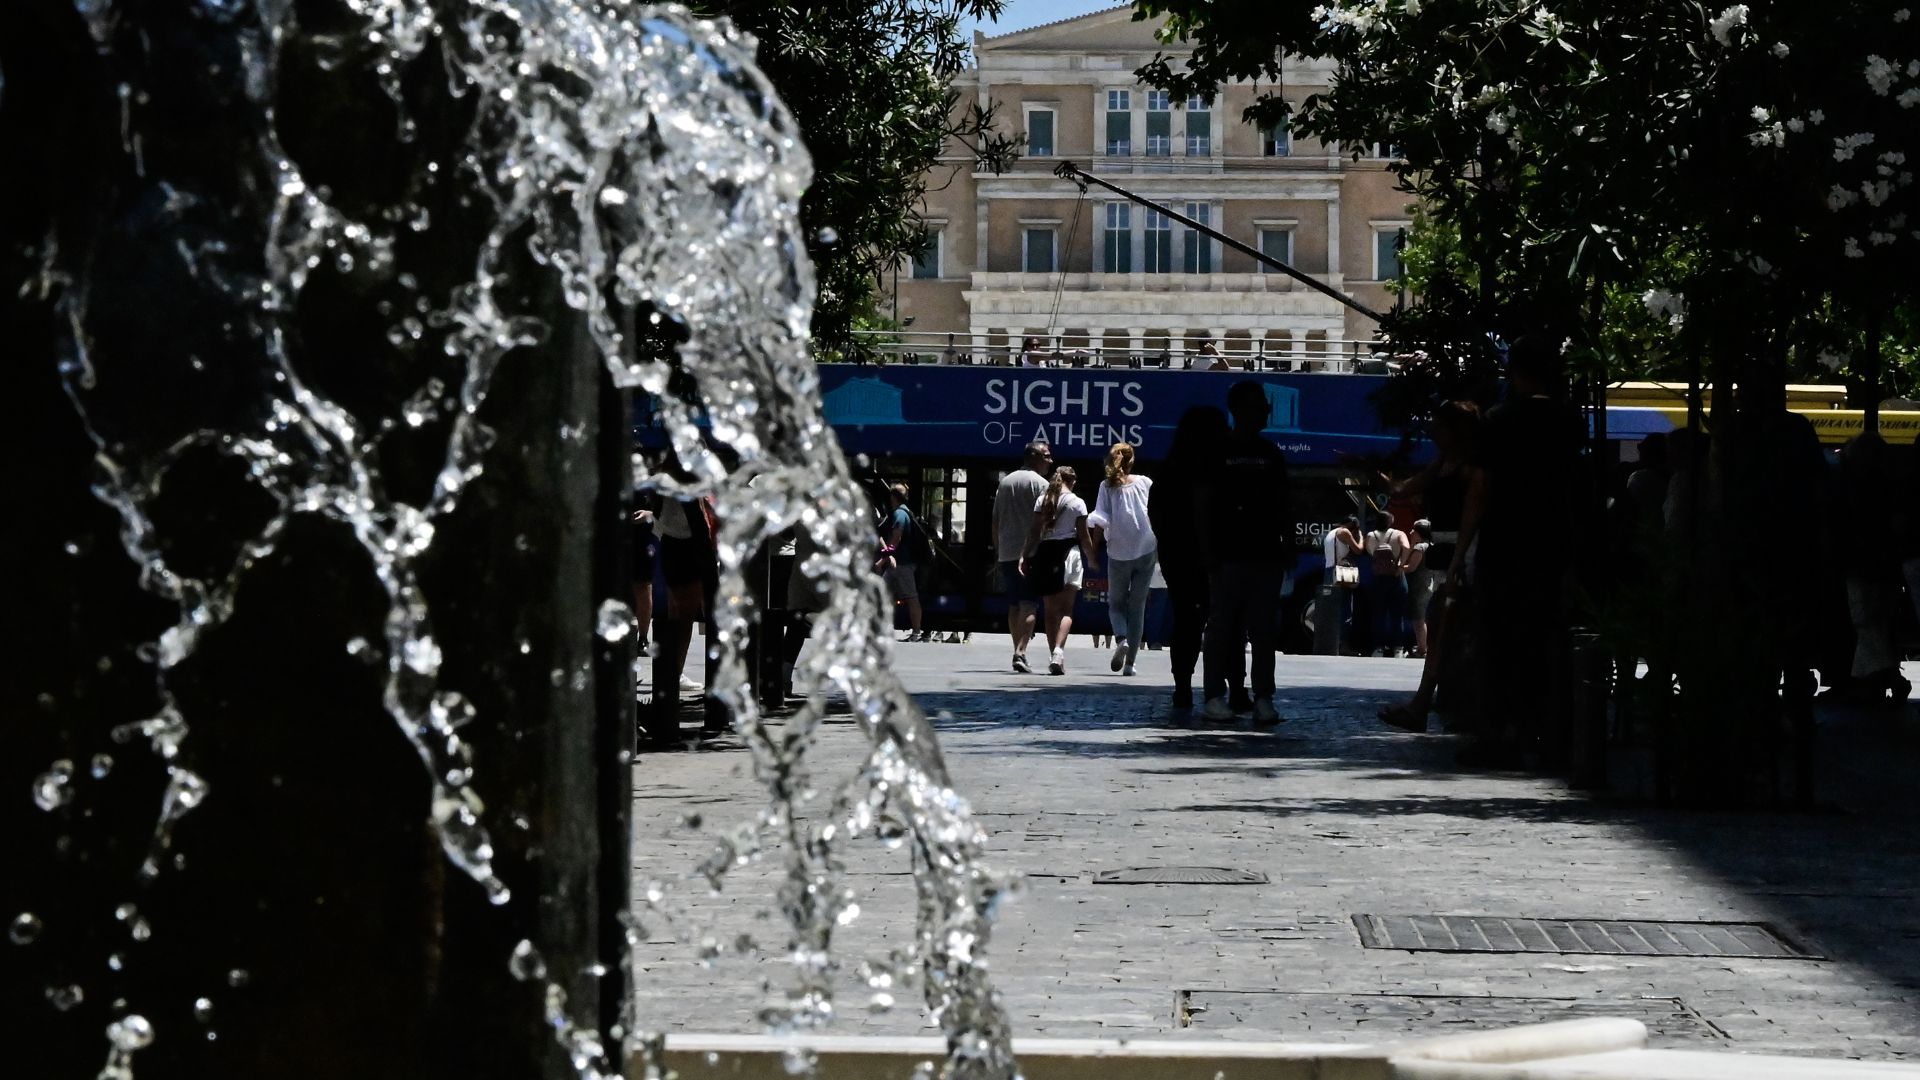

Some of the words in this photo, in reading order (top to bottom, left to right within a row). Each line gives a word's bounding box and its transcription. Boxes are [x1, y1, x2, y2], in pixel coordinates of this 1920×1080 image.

[983, 379, 1144, 417] SIGHTS
[983, 421, 1023, 445] OF
[1032, 422, 1143, 448] ATHENS
[1287, 442, 1311, 454] sights
[1295, 522, 1336, 536] SIGH
